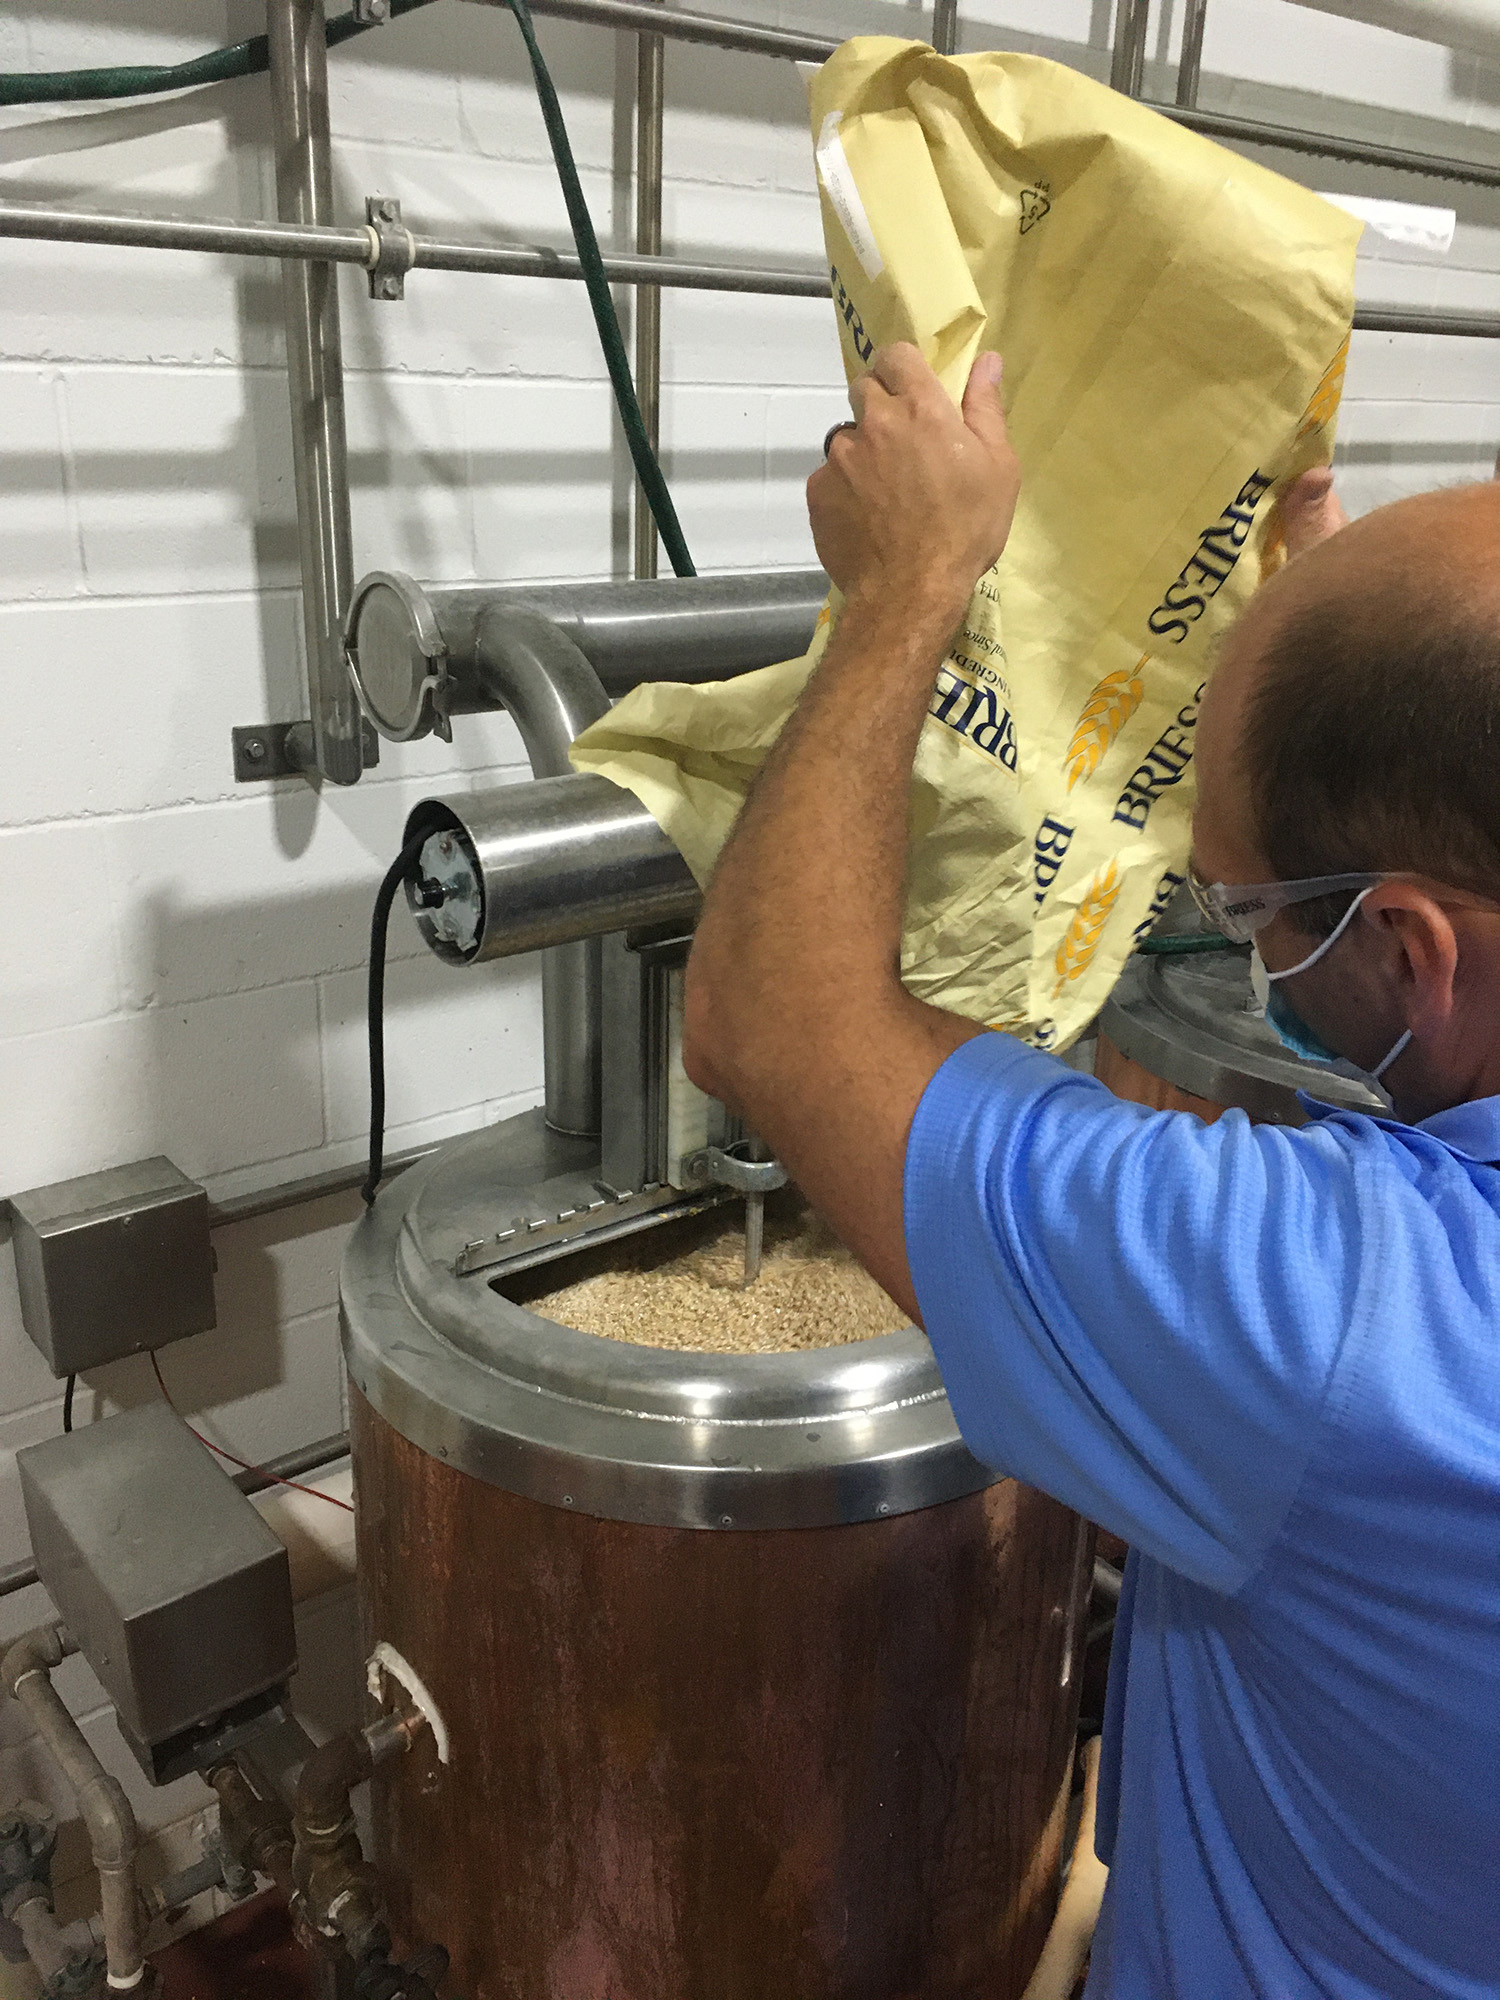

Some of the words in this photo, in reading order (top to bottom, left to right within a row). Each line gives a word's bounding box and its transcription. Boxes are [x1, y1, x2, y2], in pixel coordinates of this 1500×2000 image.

[830, 265, 876, 364] BRI
[1148, 467, 1279, 644] BRIESS
[949, 649, 1008, 693] INGREDI
[963, 630, 993, 651] Since
[927, 664, 1018, 774] BRIE
